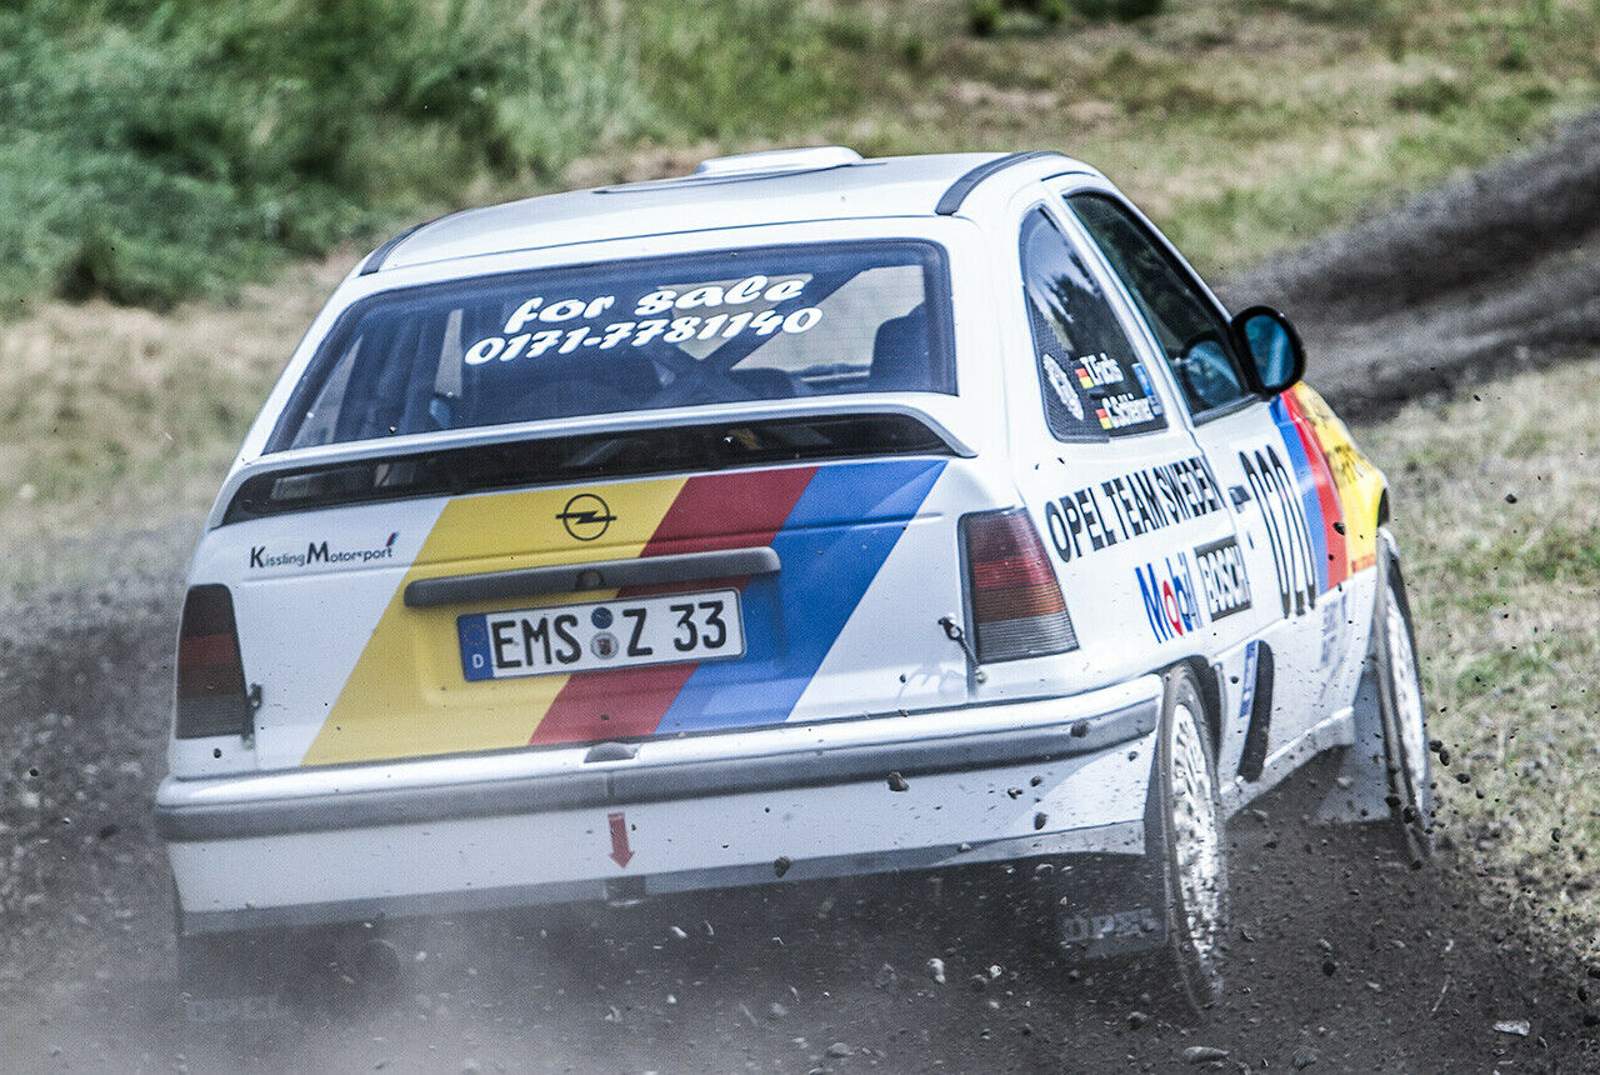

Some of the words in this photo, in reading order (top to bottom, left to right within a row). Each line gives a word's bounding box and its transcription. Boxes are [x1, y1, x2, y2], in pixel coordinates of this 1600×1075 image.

[464, 307, 824, 366] 0171-7781140
[503, 297, 615, 334] for
[634, 275, 808, 316] sale
[1045, 487, 1118, 563] OPEL
[1100, 469, 1170, 541] TEAM
[1152, 456, 1227, 524] SWEDEN
[1135, 552, 1203, 643] Mobil
[491, 614, 582, 669] EMS
[622, 608, 653, 657] Z
[670, 601, 727, 651] 33
